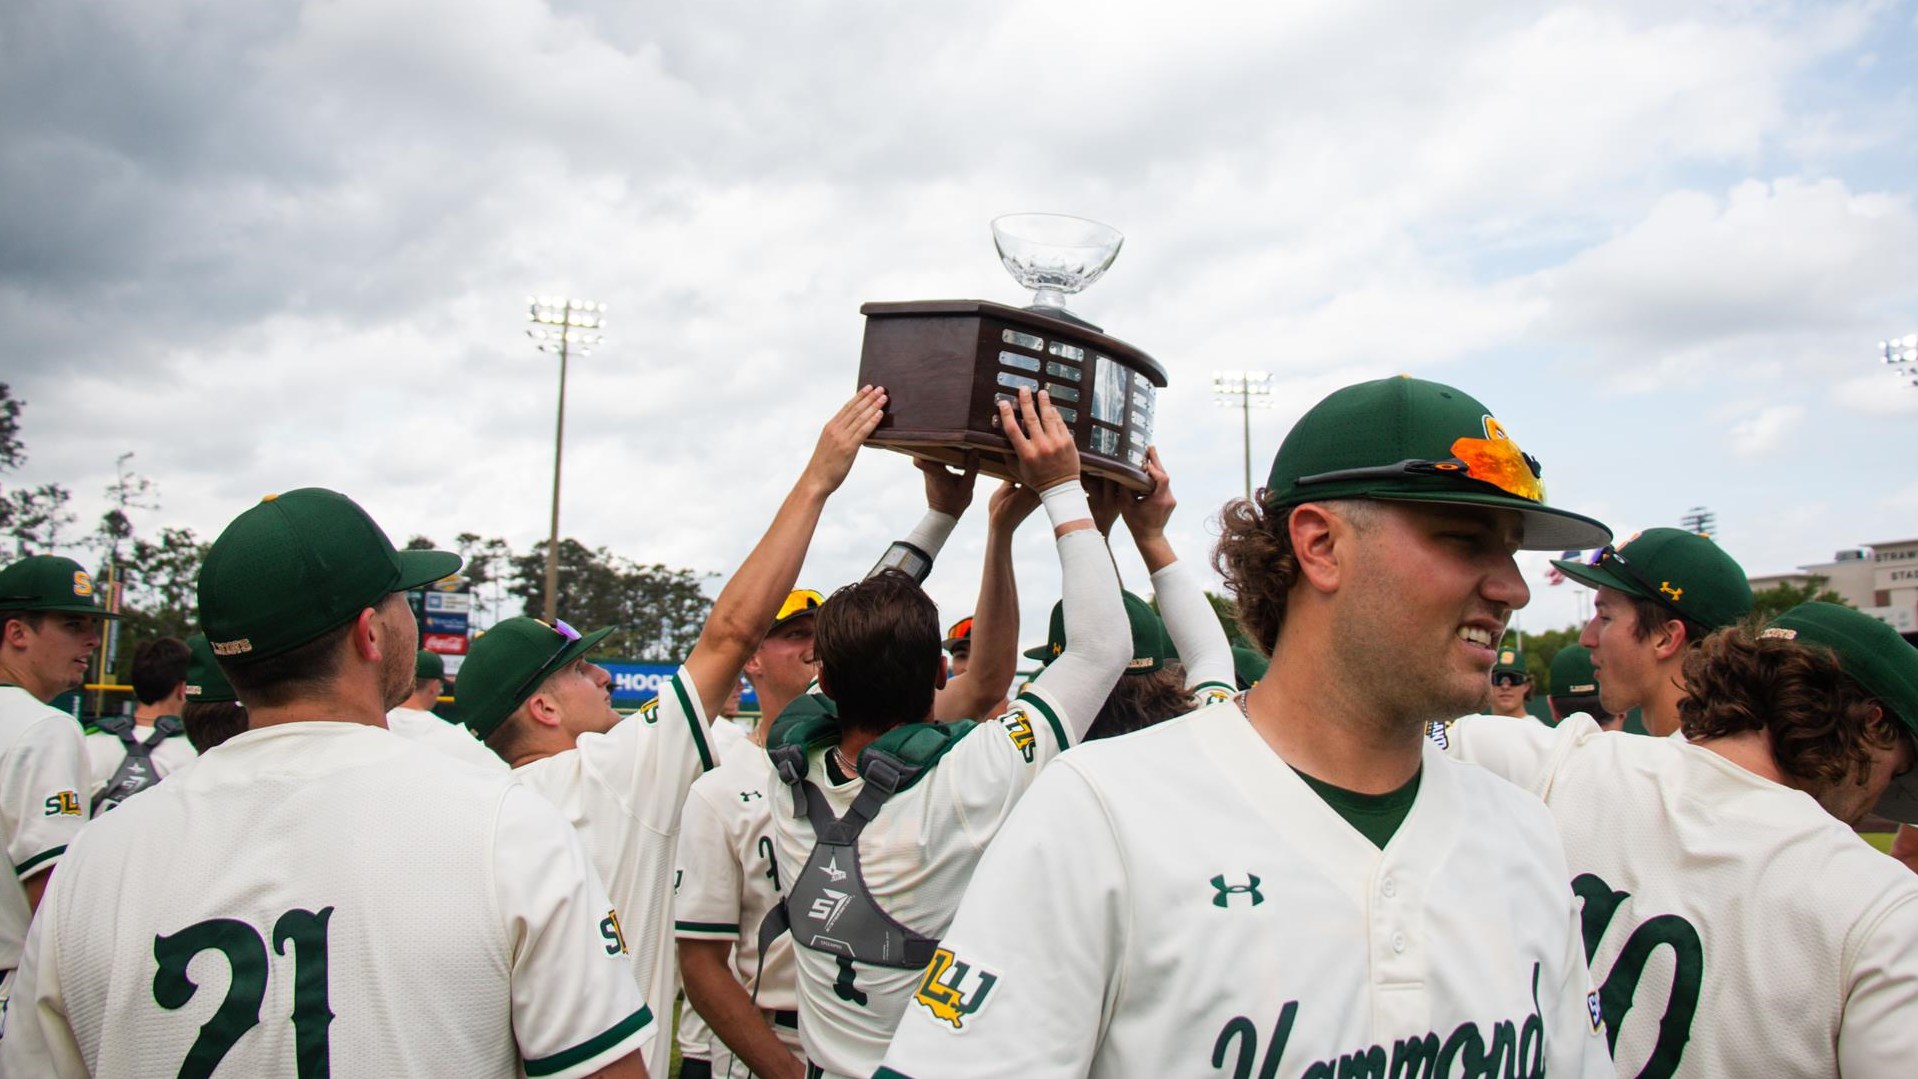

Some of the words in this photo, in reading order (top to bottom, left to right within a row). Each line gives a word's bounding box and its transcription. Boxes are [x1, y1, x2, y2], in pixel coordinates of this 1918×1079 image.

[73, 570, 93, 596] S
[615, 672, 674, 691] HOO
[152, 905, 336, 1079] 21
[1210, 960, 1548, 1079] Hmond
